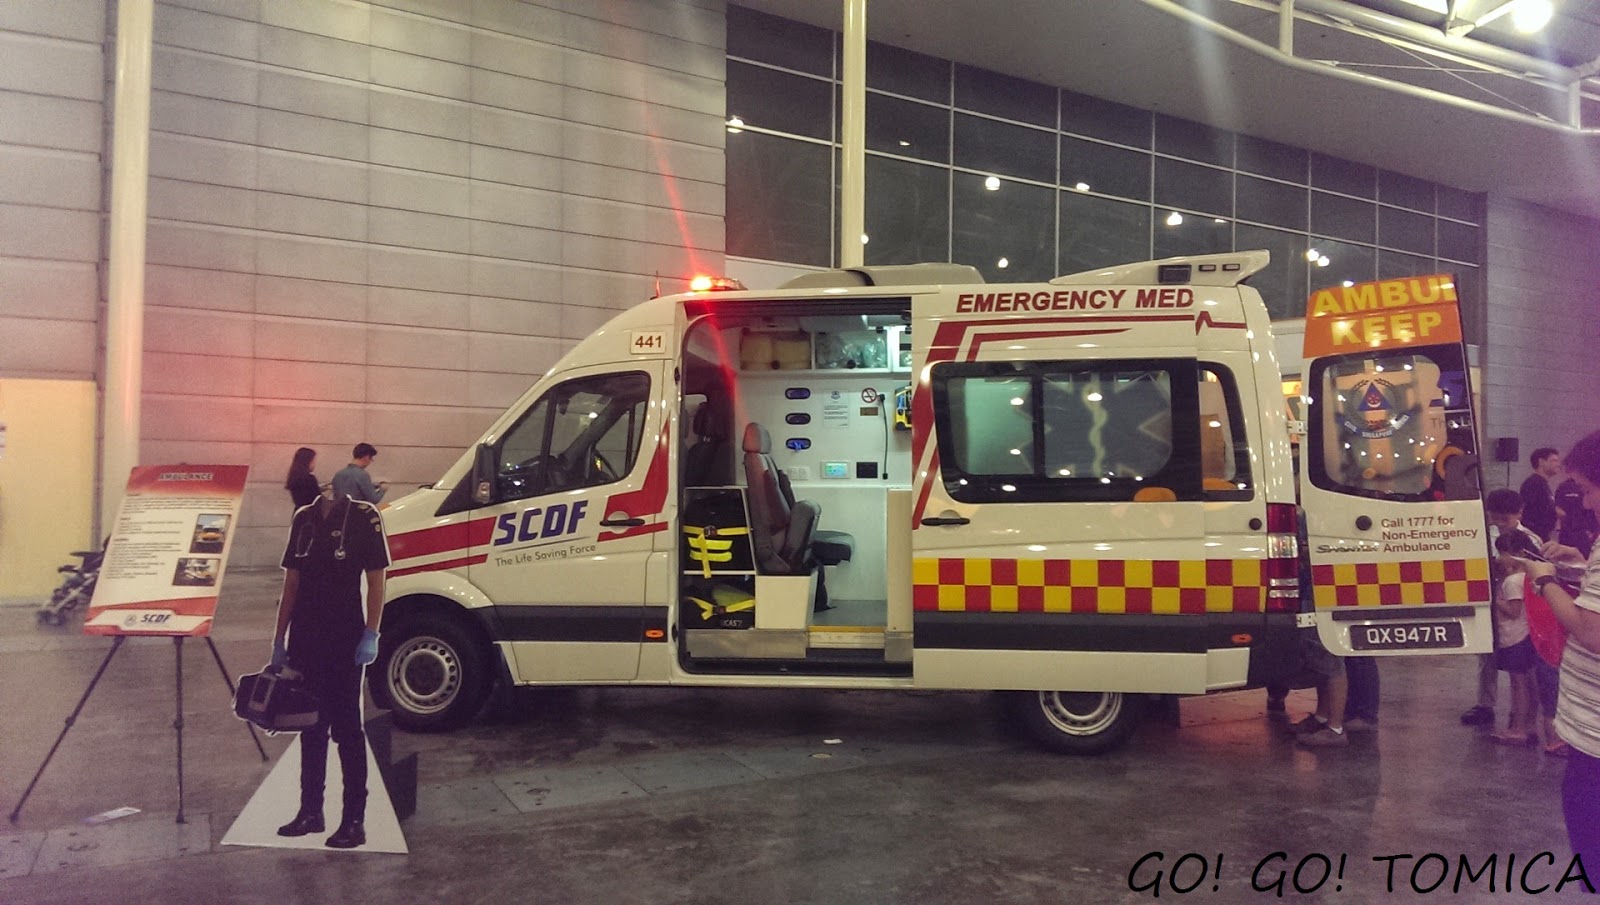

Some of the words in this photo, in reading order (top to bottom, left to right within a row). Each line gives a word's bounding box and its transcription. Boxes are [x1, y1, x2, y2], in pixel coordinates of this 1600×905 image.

[956, 289, 1126, 313] EMERGENCY
[1135, 288, 1194, 308] MED
[1331, 311, 1441, 346] KEEP
[634, 335, 662, 348] 441
[493, 500, 588, 547] SCDF
[1381, 517, 1403, 528] Call
[1407, 516, 1434, 527] 1777
[1437, 515, 1455, 526] for
[1382, 528, 1478, 541] Non-Emergency
[495, 557, 512, 567] The
[516, 552, 532, 564] Life
[535, 546, 567, 562] Saving
[570, 543, 596, 557] Force
[1383, 541, 1451, 553] Ambulance
[140, 613, 171, 623] SCDF
[1366, 626, 1448, 645] QX947R
